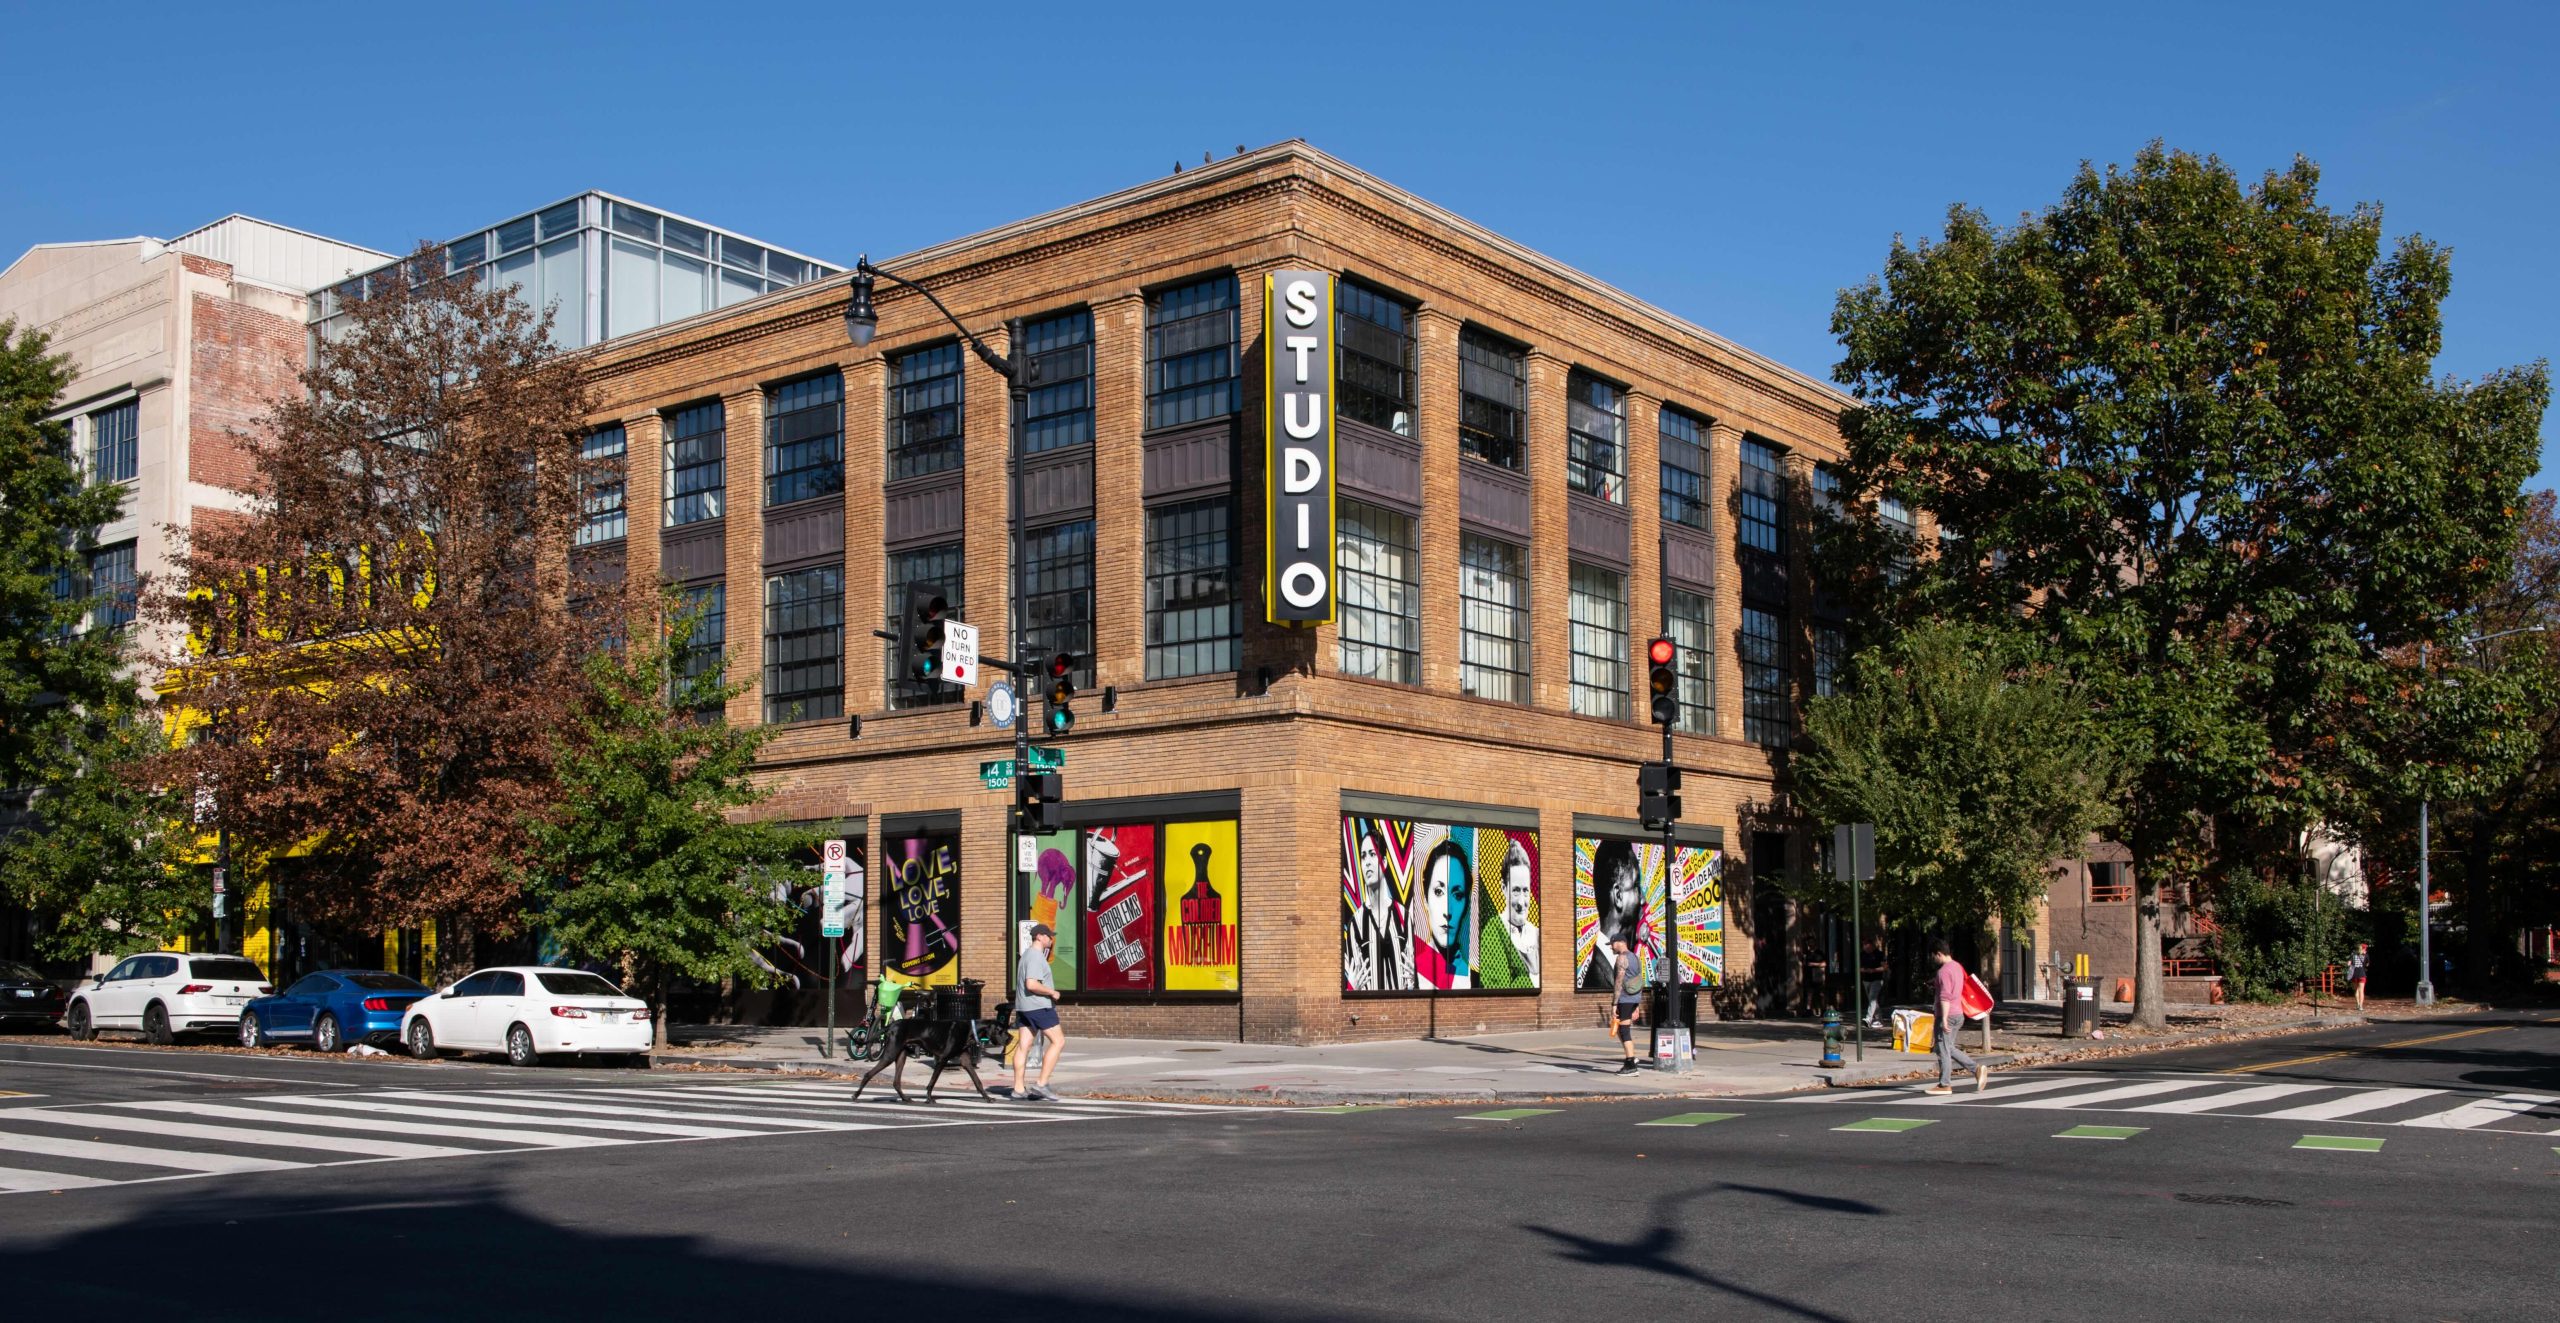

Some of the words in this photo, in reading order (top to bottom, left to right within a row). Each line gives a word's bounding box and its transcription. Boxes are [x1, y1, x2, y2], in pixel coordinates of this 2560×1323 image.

[1281, 280, 1326, 608] STUDIO
[186, 529, 437, 657] SUDIO
[953, 627, 968, 640] NO
[951, 641, 971, 653] TURN
[945, 651, 957, 662] ON
[959, 654, 975, 666] RED
[987, 763, 999, 777] 14
[988, 777, 1009, 787] 1500
[890, 845, 957, 892] LOVE,
[900, 876, 950, 910] LOVE,
[1196, 881, 1208, 899] THE
[1683, 878, 1696, 896] REAT
[908, 899, 940, 922] LOVE
[1098, 893, 1142, 938] PROBLEMS
[1181, 897, 1221, 924] COLORED
[1168, 924, 1236, 967] MUSEUM
[1694, 929, 1722, 944] BRENDA!
[1095, 931, 1127, 964] BETWEEN
[1116, 939, 1145, 971] SISTERS
[1686, 942, 1701, 956] TRULY
[901, 956, 921, 969] COMING
[921, 952, 936, 964] SOON
[1681, 954, 1695, 968] LOCAL
[1678, 964, 1693, 981] ONG!
